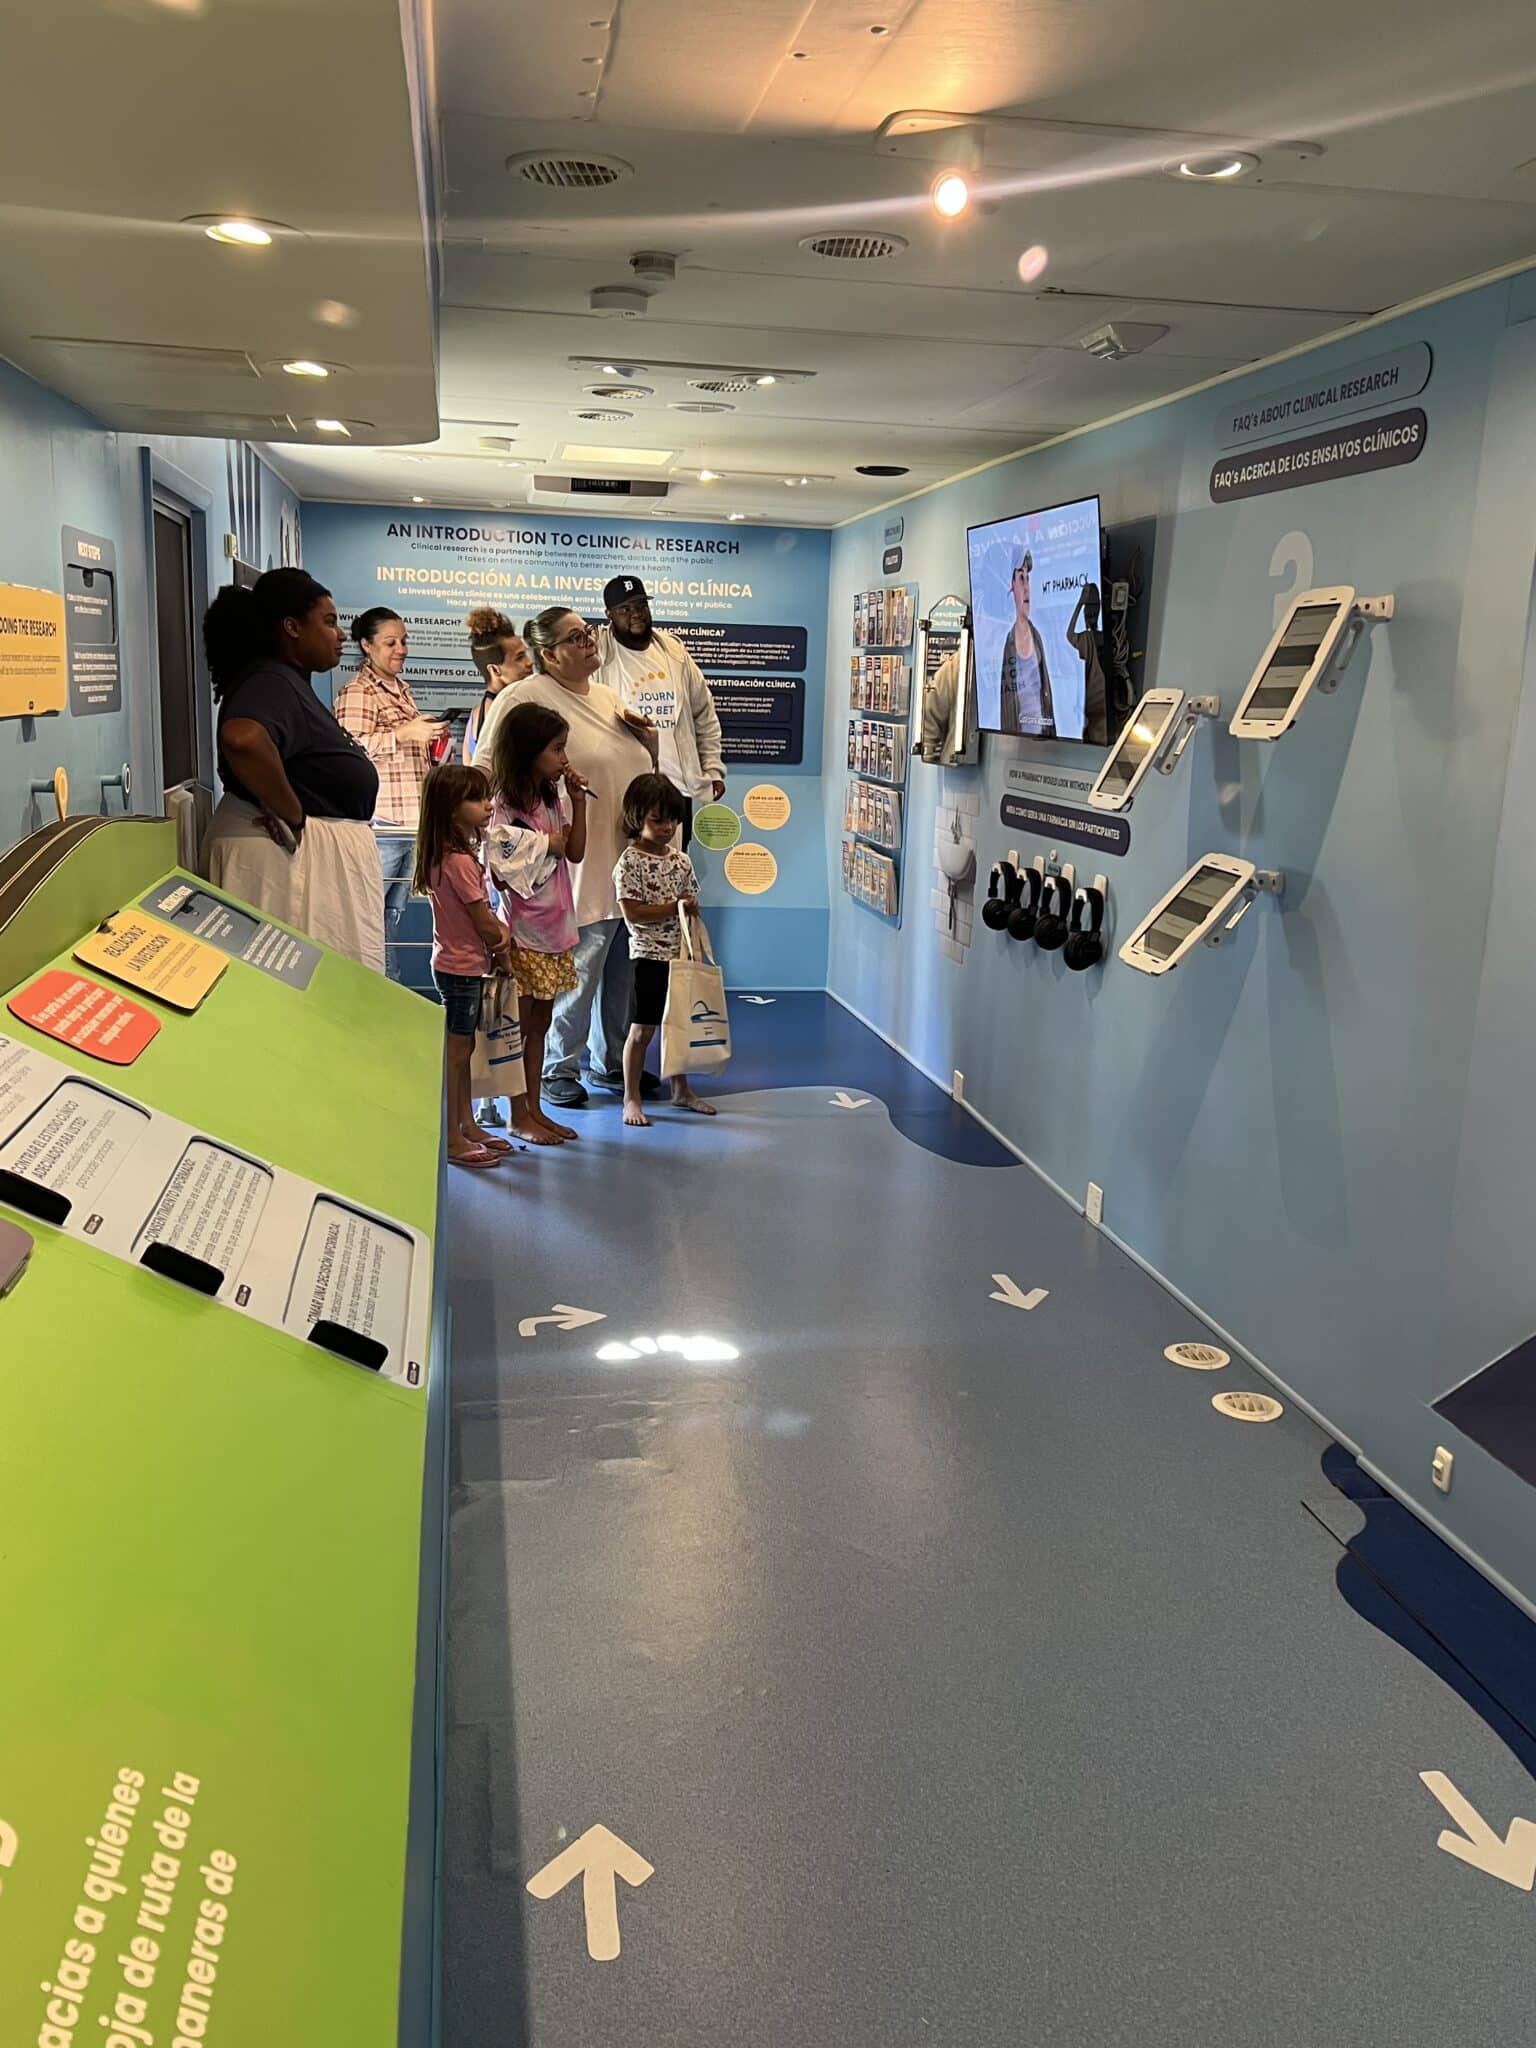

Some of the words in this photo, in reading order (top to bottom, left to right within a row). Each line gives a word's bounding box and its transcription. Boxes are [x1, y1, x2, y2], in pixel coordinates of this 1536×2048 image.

[1233, 414, 1259, 432] FAQ's
[1260, 402, 1291, 424] ABOUT
[1292, 392, 1338, 414] CLINICAL
[1340, 367, 1399, 400] RESEARCH
[1214, 467, 1239, 489] FAQ's
[1240, 461, 1276, 483] ACERCA
[1278, 457, 1291, 474] DE
[1292, 454, 1310, 470] LOS
[1311, 441, 1361, 466] ENSAYOS
[1363, 424, 1419, 452] CLÍNICOS
[387, 523, 411, 538] AN
[416, 524, 546, 545] INTRODUCTION
[551, 532, 573, 547] TO
[577, 534, 651, 550] CLINICAL
[656, 538, 740, 554] RESEARCH
[411, 542, 442, 551] Clinical
[442, 544, 479, 553] research
[495, 547, 543, 557] partnership
[544, 549, 577, 558] between
[659, 555, 676, 563] and
[676, 555, 689, 563] the
[464, 555, 486, 563] takes
[500, 556, 523, 565] entire
[524, 558, 568, 569] community
[570, 560, 578, 568] to
[580, 561, 603, 569] better
[604, 563, 645, 572] everyone's
[376, 566, 511, 587] INTRODUCCIÓN
[515, 574, 527, 587] A
[530, 575, 551, 588] LA
[555, 574, 684, 595] INVESCIÓN
[688, 579, 752, 598] CLÍNICA
[409, 587, 464, 598] investigación
[18, 618, 29, 635] THE
[29, 620, 57, 637] RESEARCH
[414, 617, 462, 626] RESEARCH?
[690, 627, 725, 637] CLÍNICA?
[405, 668, 428, 676] MAIN
[429, 669, 454, 677] TYPES
[705, 678, 764, 688] INVESTIGACIÓN
[765, 679, 796, 688] CLÍNICA
[638, 705, 653, 715] TO
[656, 705, 674, 715] BET
[639, 691, 674, 702] JOURN
[655, 719, 676, 729] ALTH
[1085, 822, 1120, 840] PARTICIPANTES
[32, 1139, 47, 1148] EL
[38, 1119, 63, 1142] ESTUDIO
[11, 1145, 41, 1174] CONTRAR
[32, 1146, 63, 1179] ADECUADO
[55, 1132, 75, 1148] PARA
[144, 1190, 179, 1243] CONSENTIMIENTO
[317, 1257, 332, 1286] DECISIÓN
[313, 1285, 326, 1301] UNA
[307, 1299, 323, 1324] TOMAR
[162, 1771, 200, 1806] la
[83, 1766, 145, 1902] quienes
[153, 1806, 192, 1850] de
[199, 1849, 238, 1896] de
[137, 1851, 181, 1933] ruta
[73, 1904, 106, 1934] a
[117, 1936, 161, 1989] de
[172, 1899, 228, 2048] aneras
[37, 1938, 97, 2048] acias
